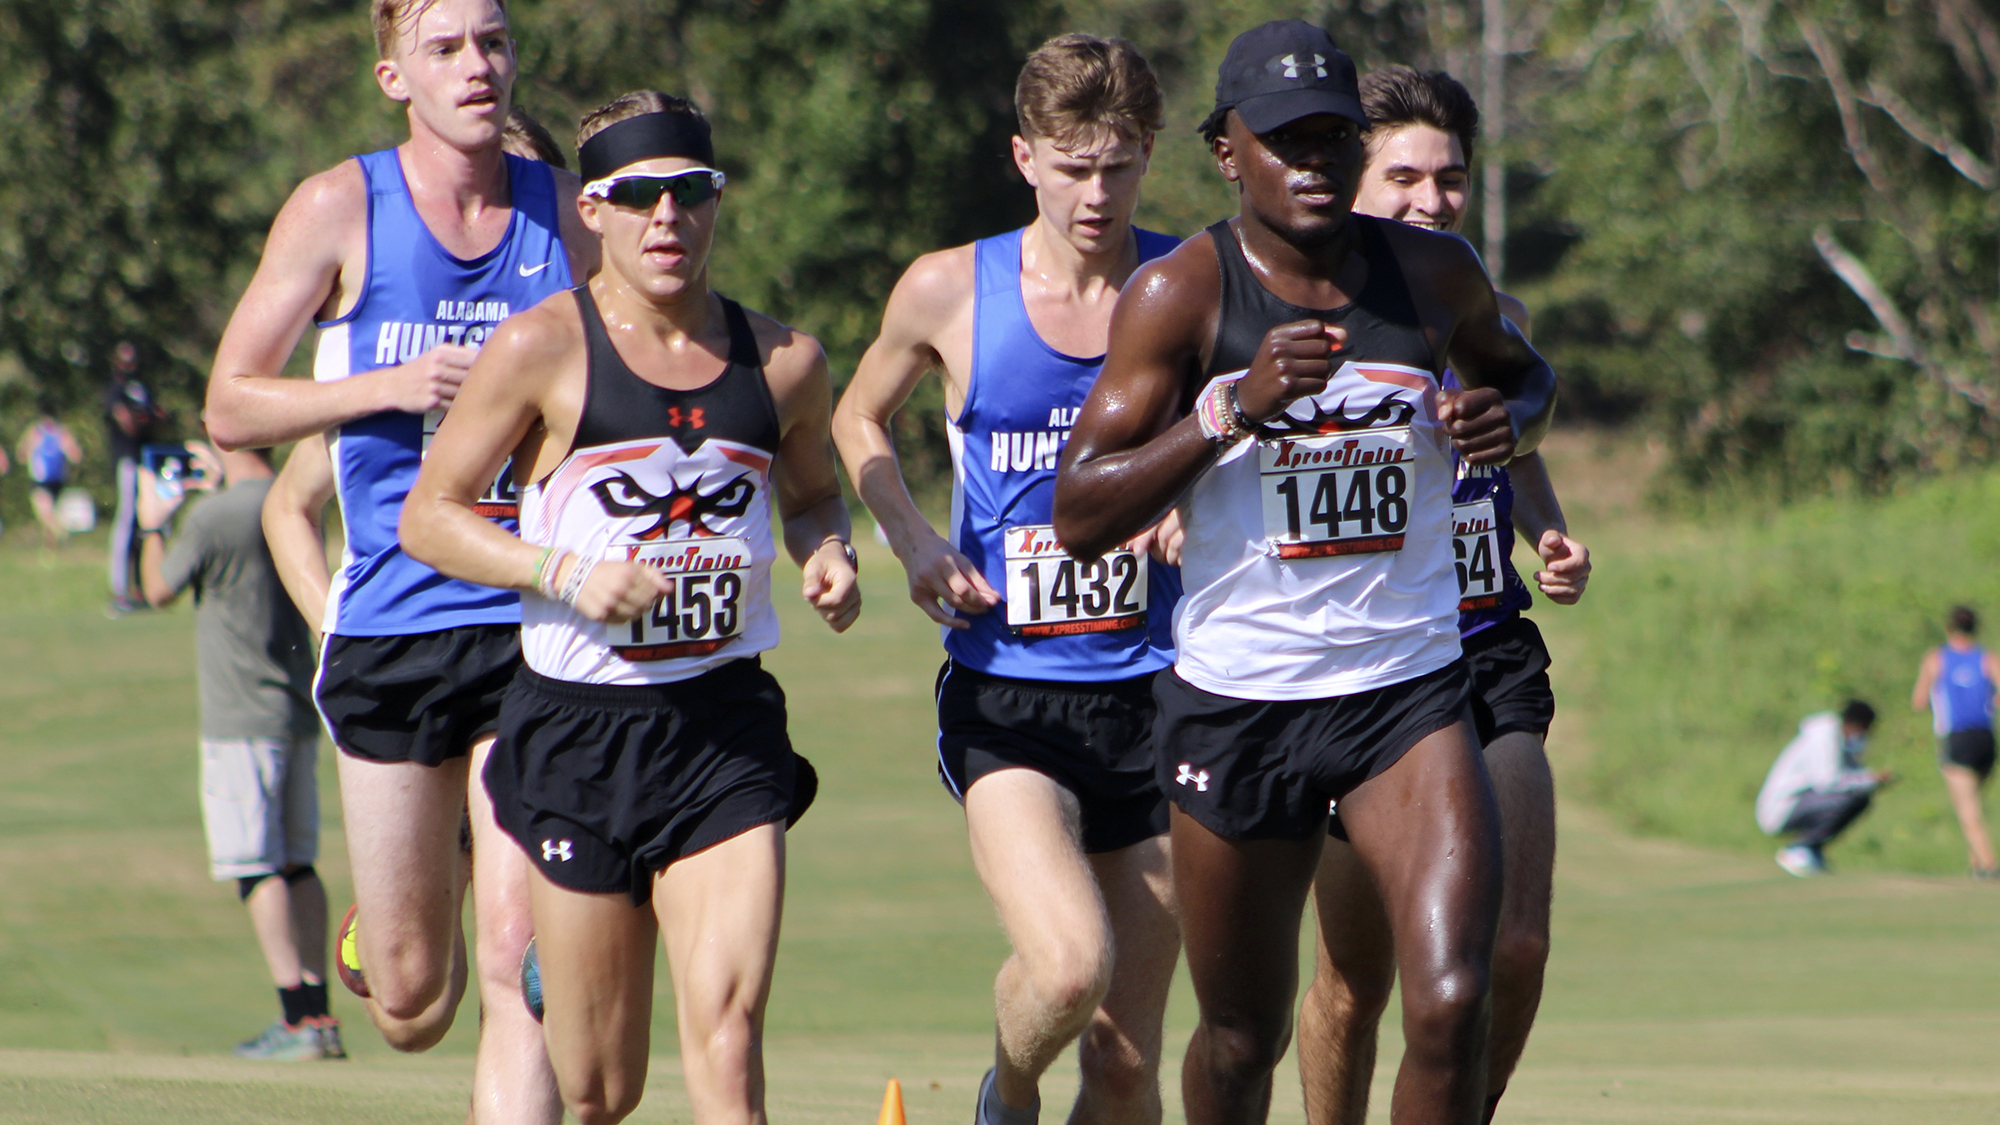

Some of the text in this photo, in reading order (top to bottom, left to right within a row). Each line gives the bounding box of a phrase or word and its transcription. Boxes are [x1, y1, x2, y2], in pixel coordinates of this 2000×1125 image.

[436, 300, 509, 321] ALABAMA
[375, 322, 496, 365] HUNTS
[991, 431, 1070, 473] HUN
[1276, 465, 1408, 541] 1448
[1021, 554, 1139, 622] 1432
[1021, 616, 1139, 637] WWW.XPRESSTIMING.COM
